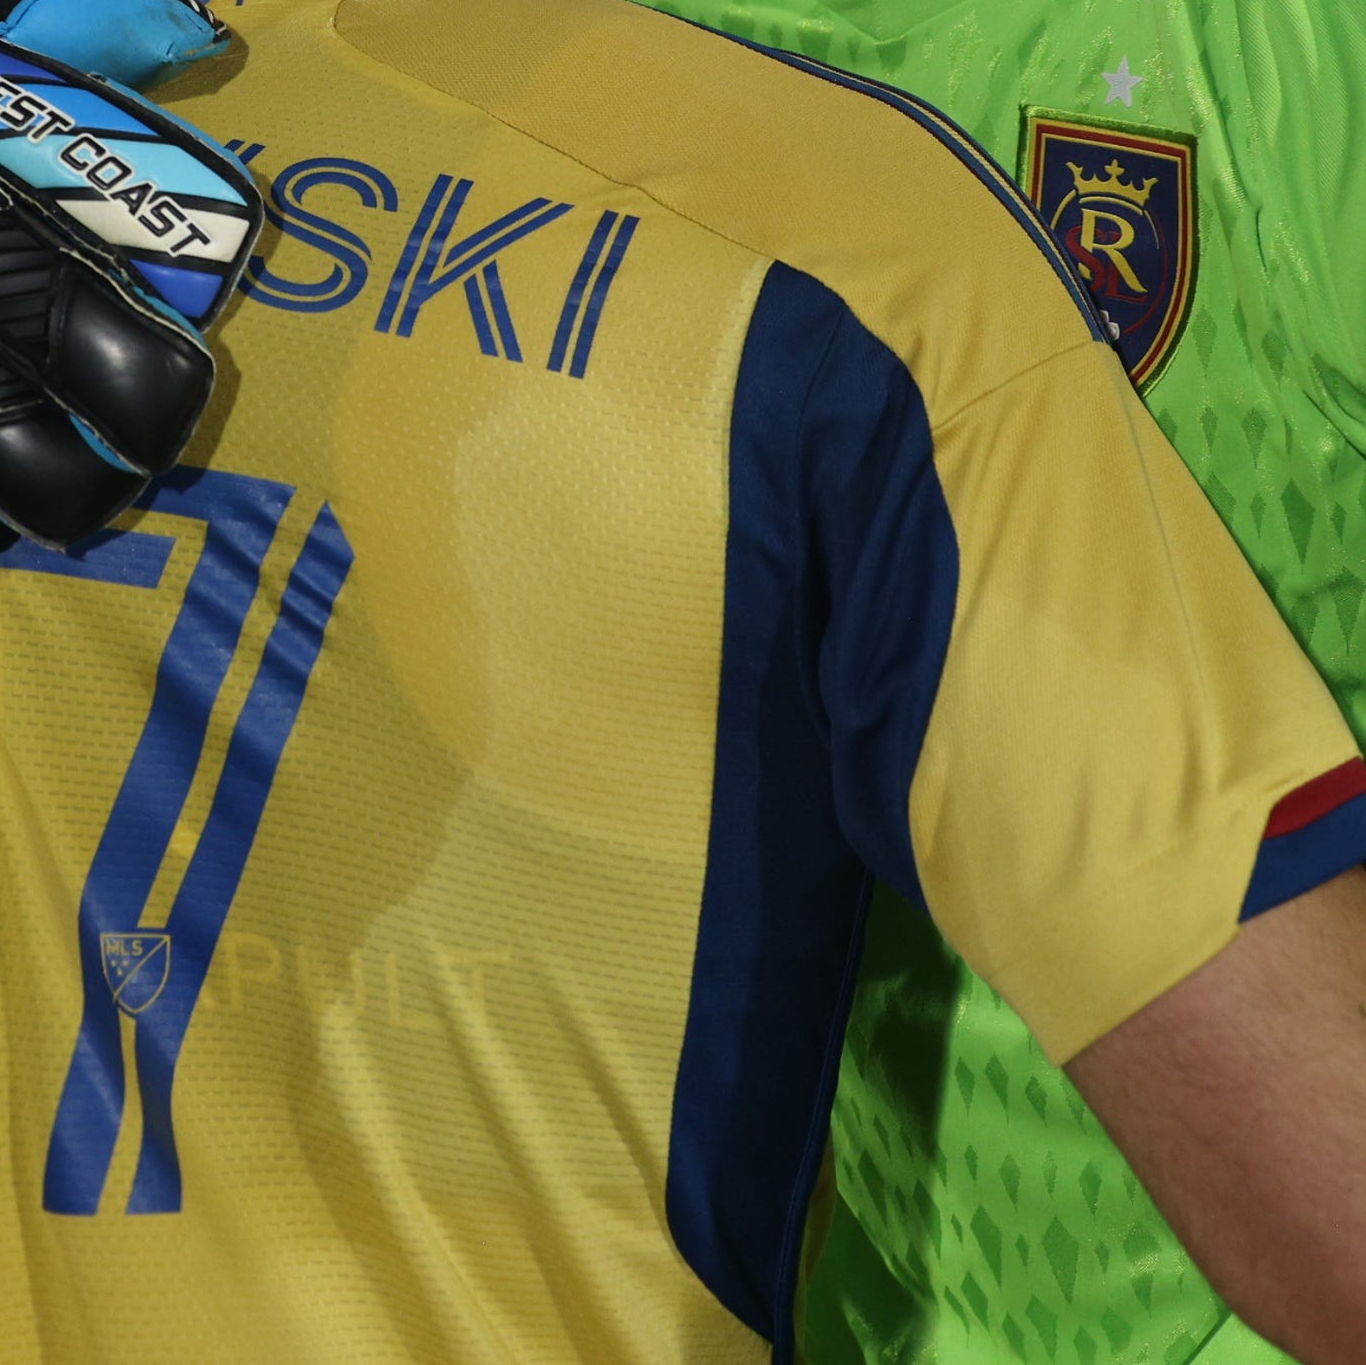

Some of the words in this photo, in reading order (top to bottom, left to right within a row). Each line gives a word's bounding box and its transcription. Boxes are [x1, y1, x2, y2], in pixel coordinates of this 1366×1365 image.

[58, 133, 212, 257] COAST
[225, 138, 641, 380] SKI
[105, 939, 143, 957] MLS
[220, 931, 517, 1031] PULT
